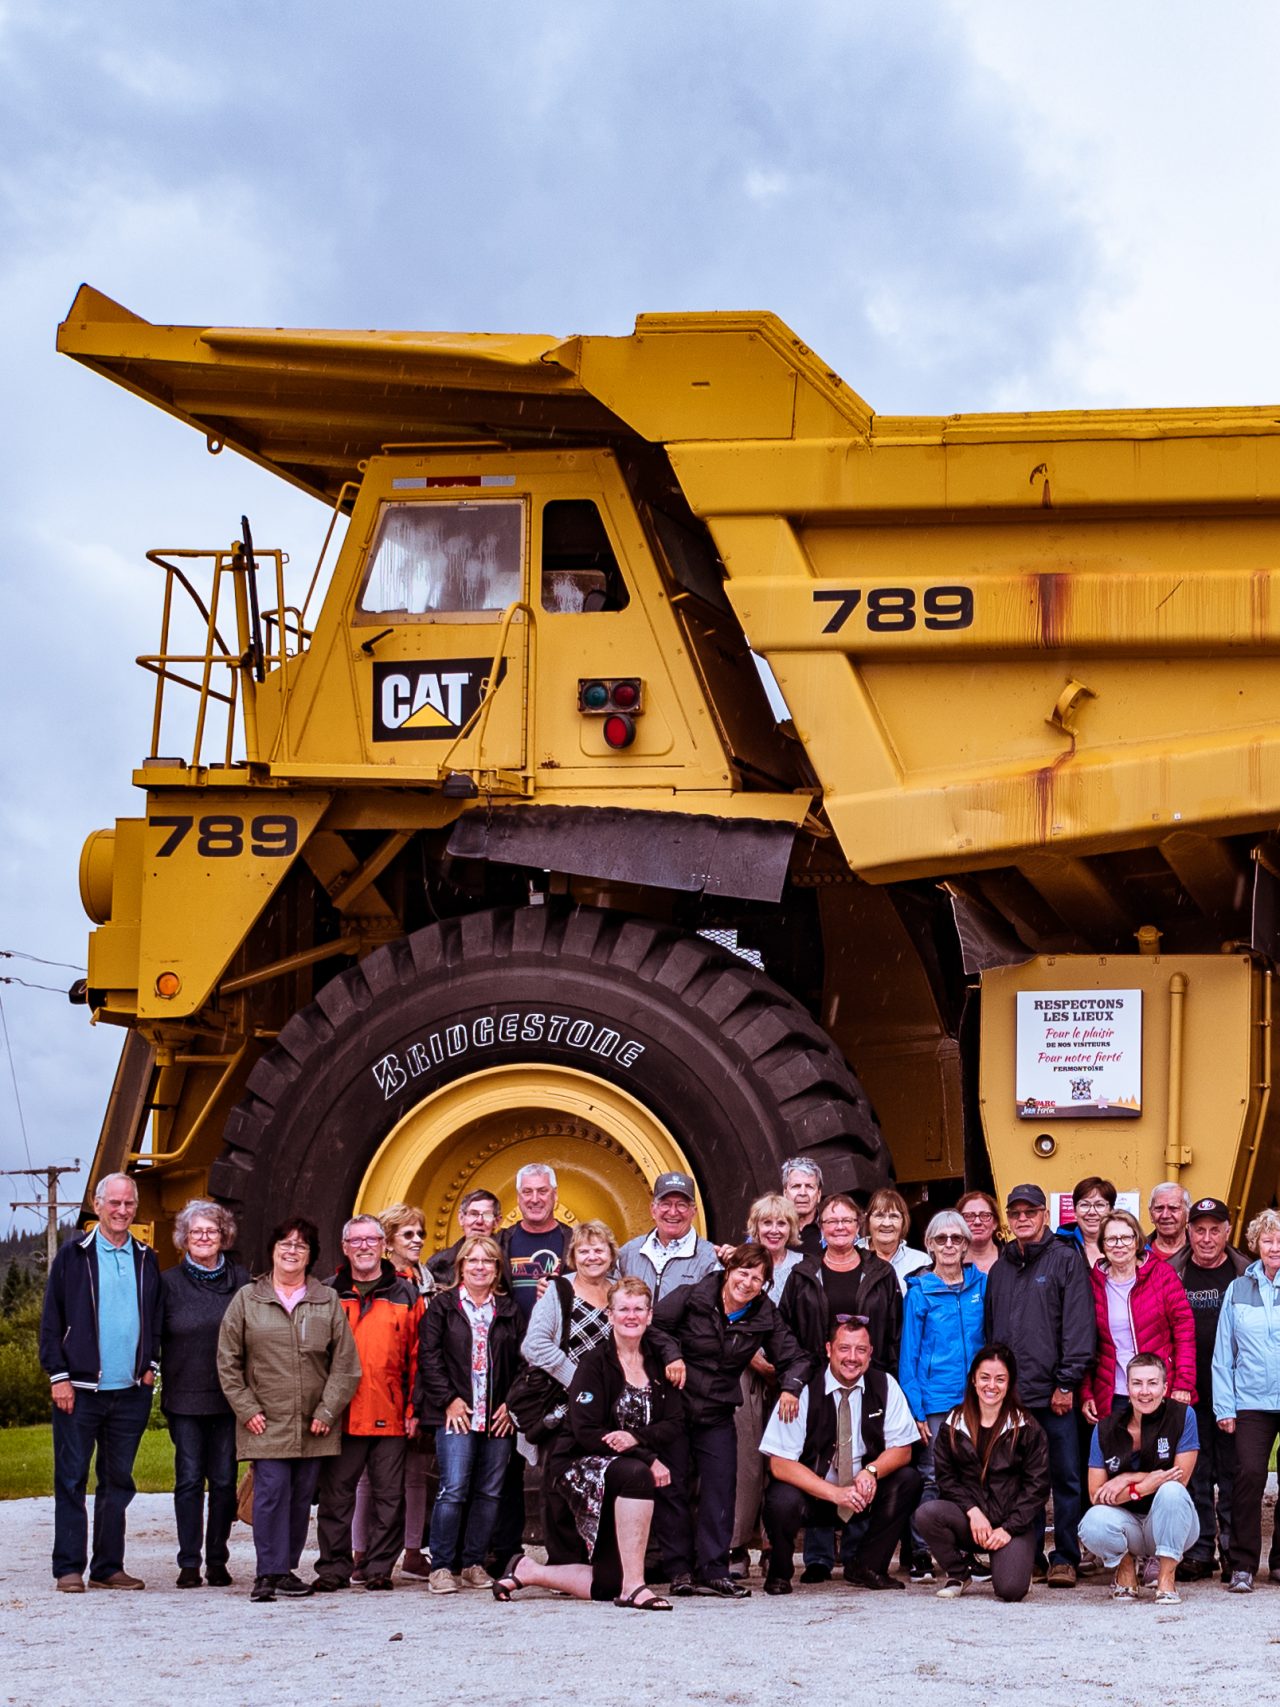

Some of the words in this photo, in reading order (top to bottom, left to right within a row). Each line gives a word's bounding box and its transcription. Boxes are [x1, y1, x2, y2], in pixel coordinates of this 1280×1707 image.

[813, 586, 974, 634] 789
[382, 672, 469, 729] CAT
[149, 815, 298, 858] 789
[1034, 999, 1124, 1010] RESPECTONS
[1043, 1012, 1069, 1021] LES
[1073, 1011, 1114, 1021] LIEUX
[1046, 1027, 1070, 1039] Pour
[1072, 1026, 1081, 1039] le
[1082, 1026, 1115, 1041] plaisir
[372, 1013, 645, 1100] BRIDGESTONE
[1037, 1052, 1062, 1063] Pour
[1064, 1052, 1092, 1063] notre
[1092, 1051, 1123, 1065] fierté
